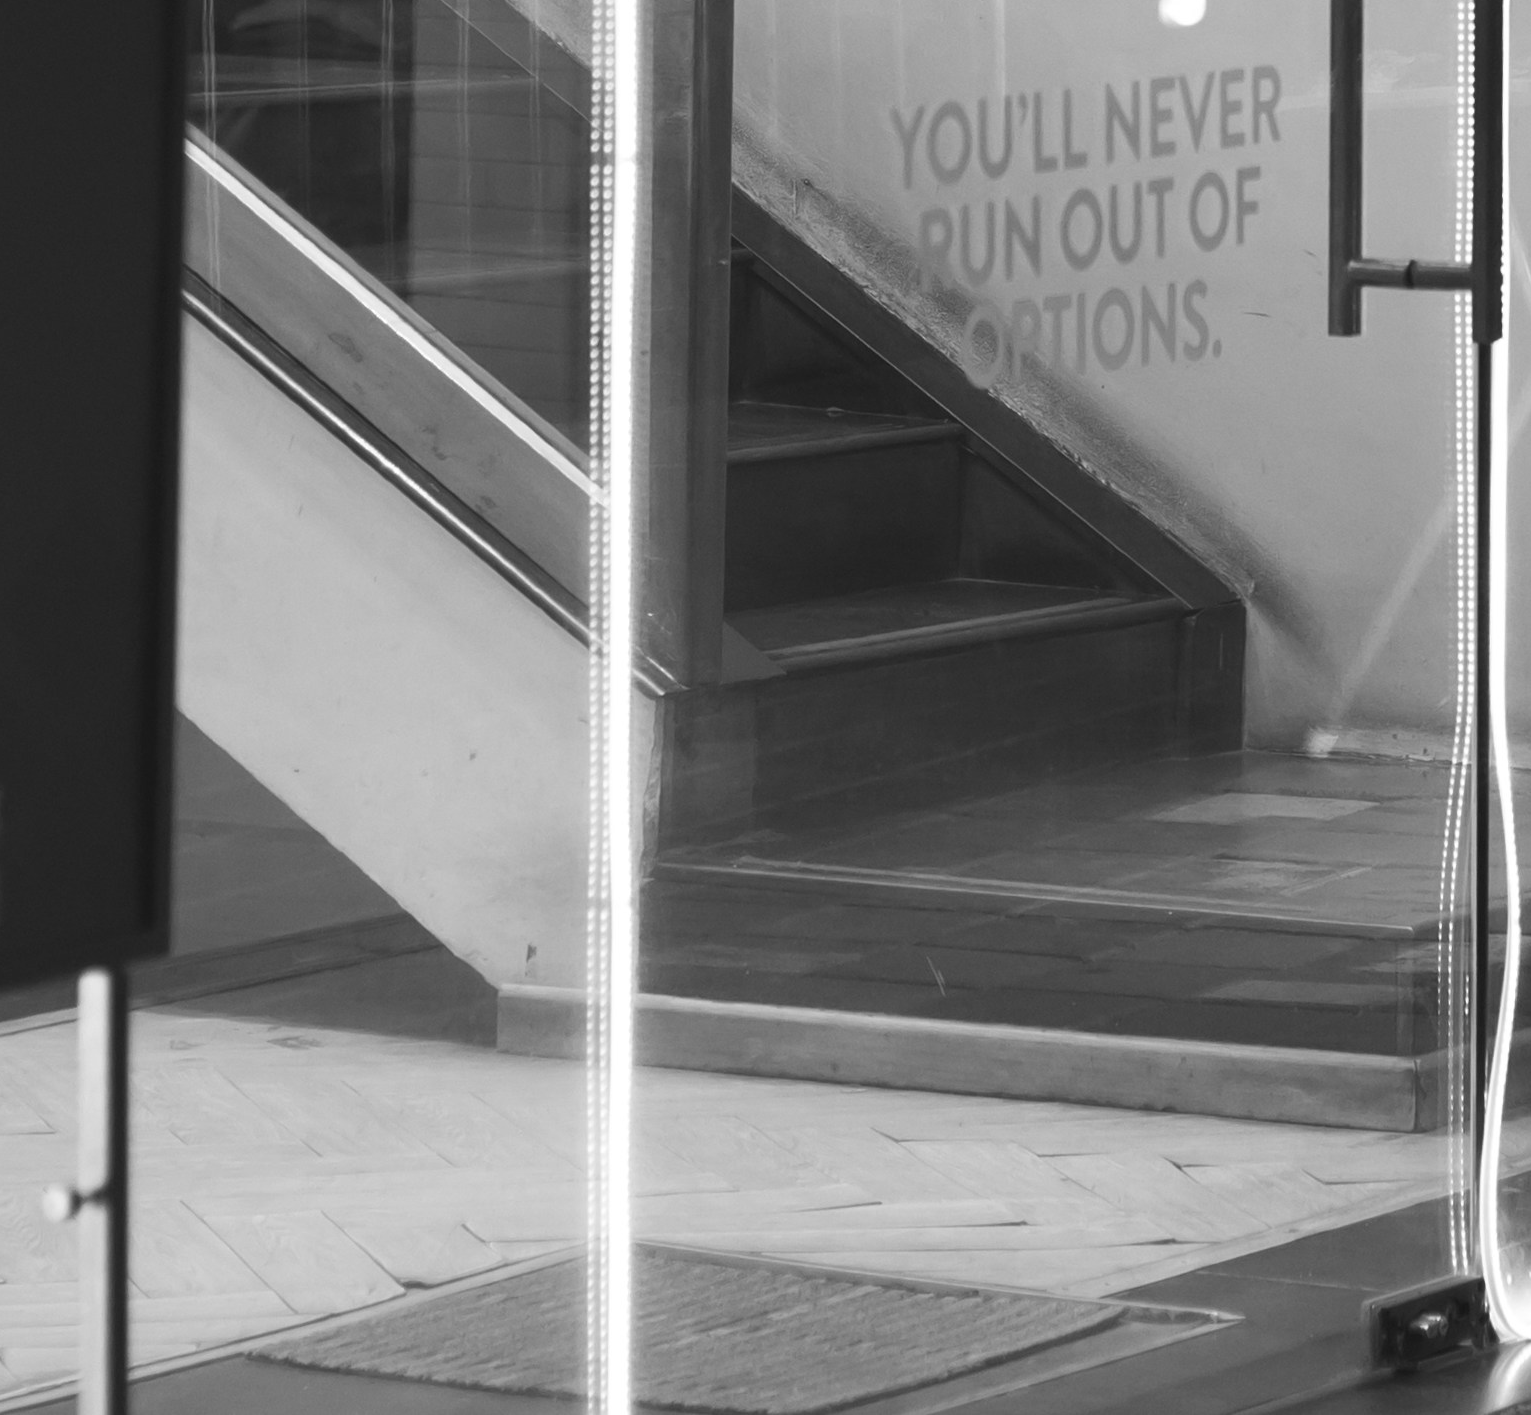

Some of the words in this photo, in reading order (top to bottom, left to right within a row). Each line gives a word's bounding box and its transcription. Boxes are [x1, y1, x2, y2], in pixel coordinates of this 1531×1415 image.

[1103, 65, 1282, 170] NEVER
[919, 205, 1042, 293] RUN
[1060, 175, 1174, 266] OUT
[1189, 165, 1262, 256] OF
